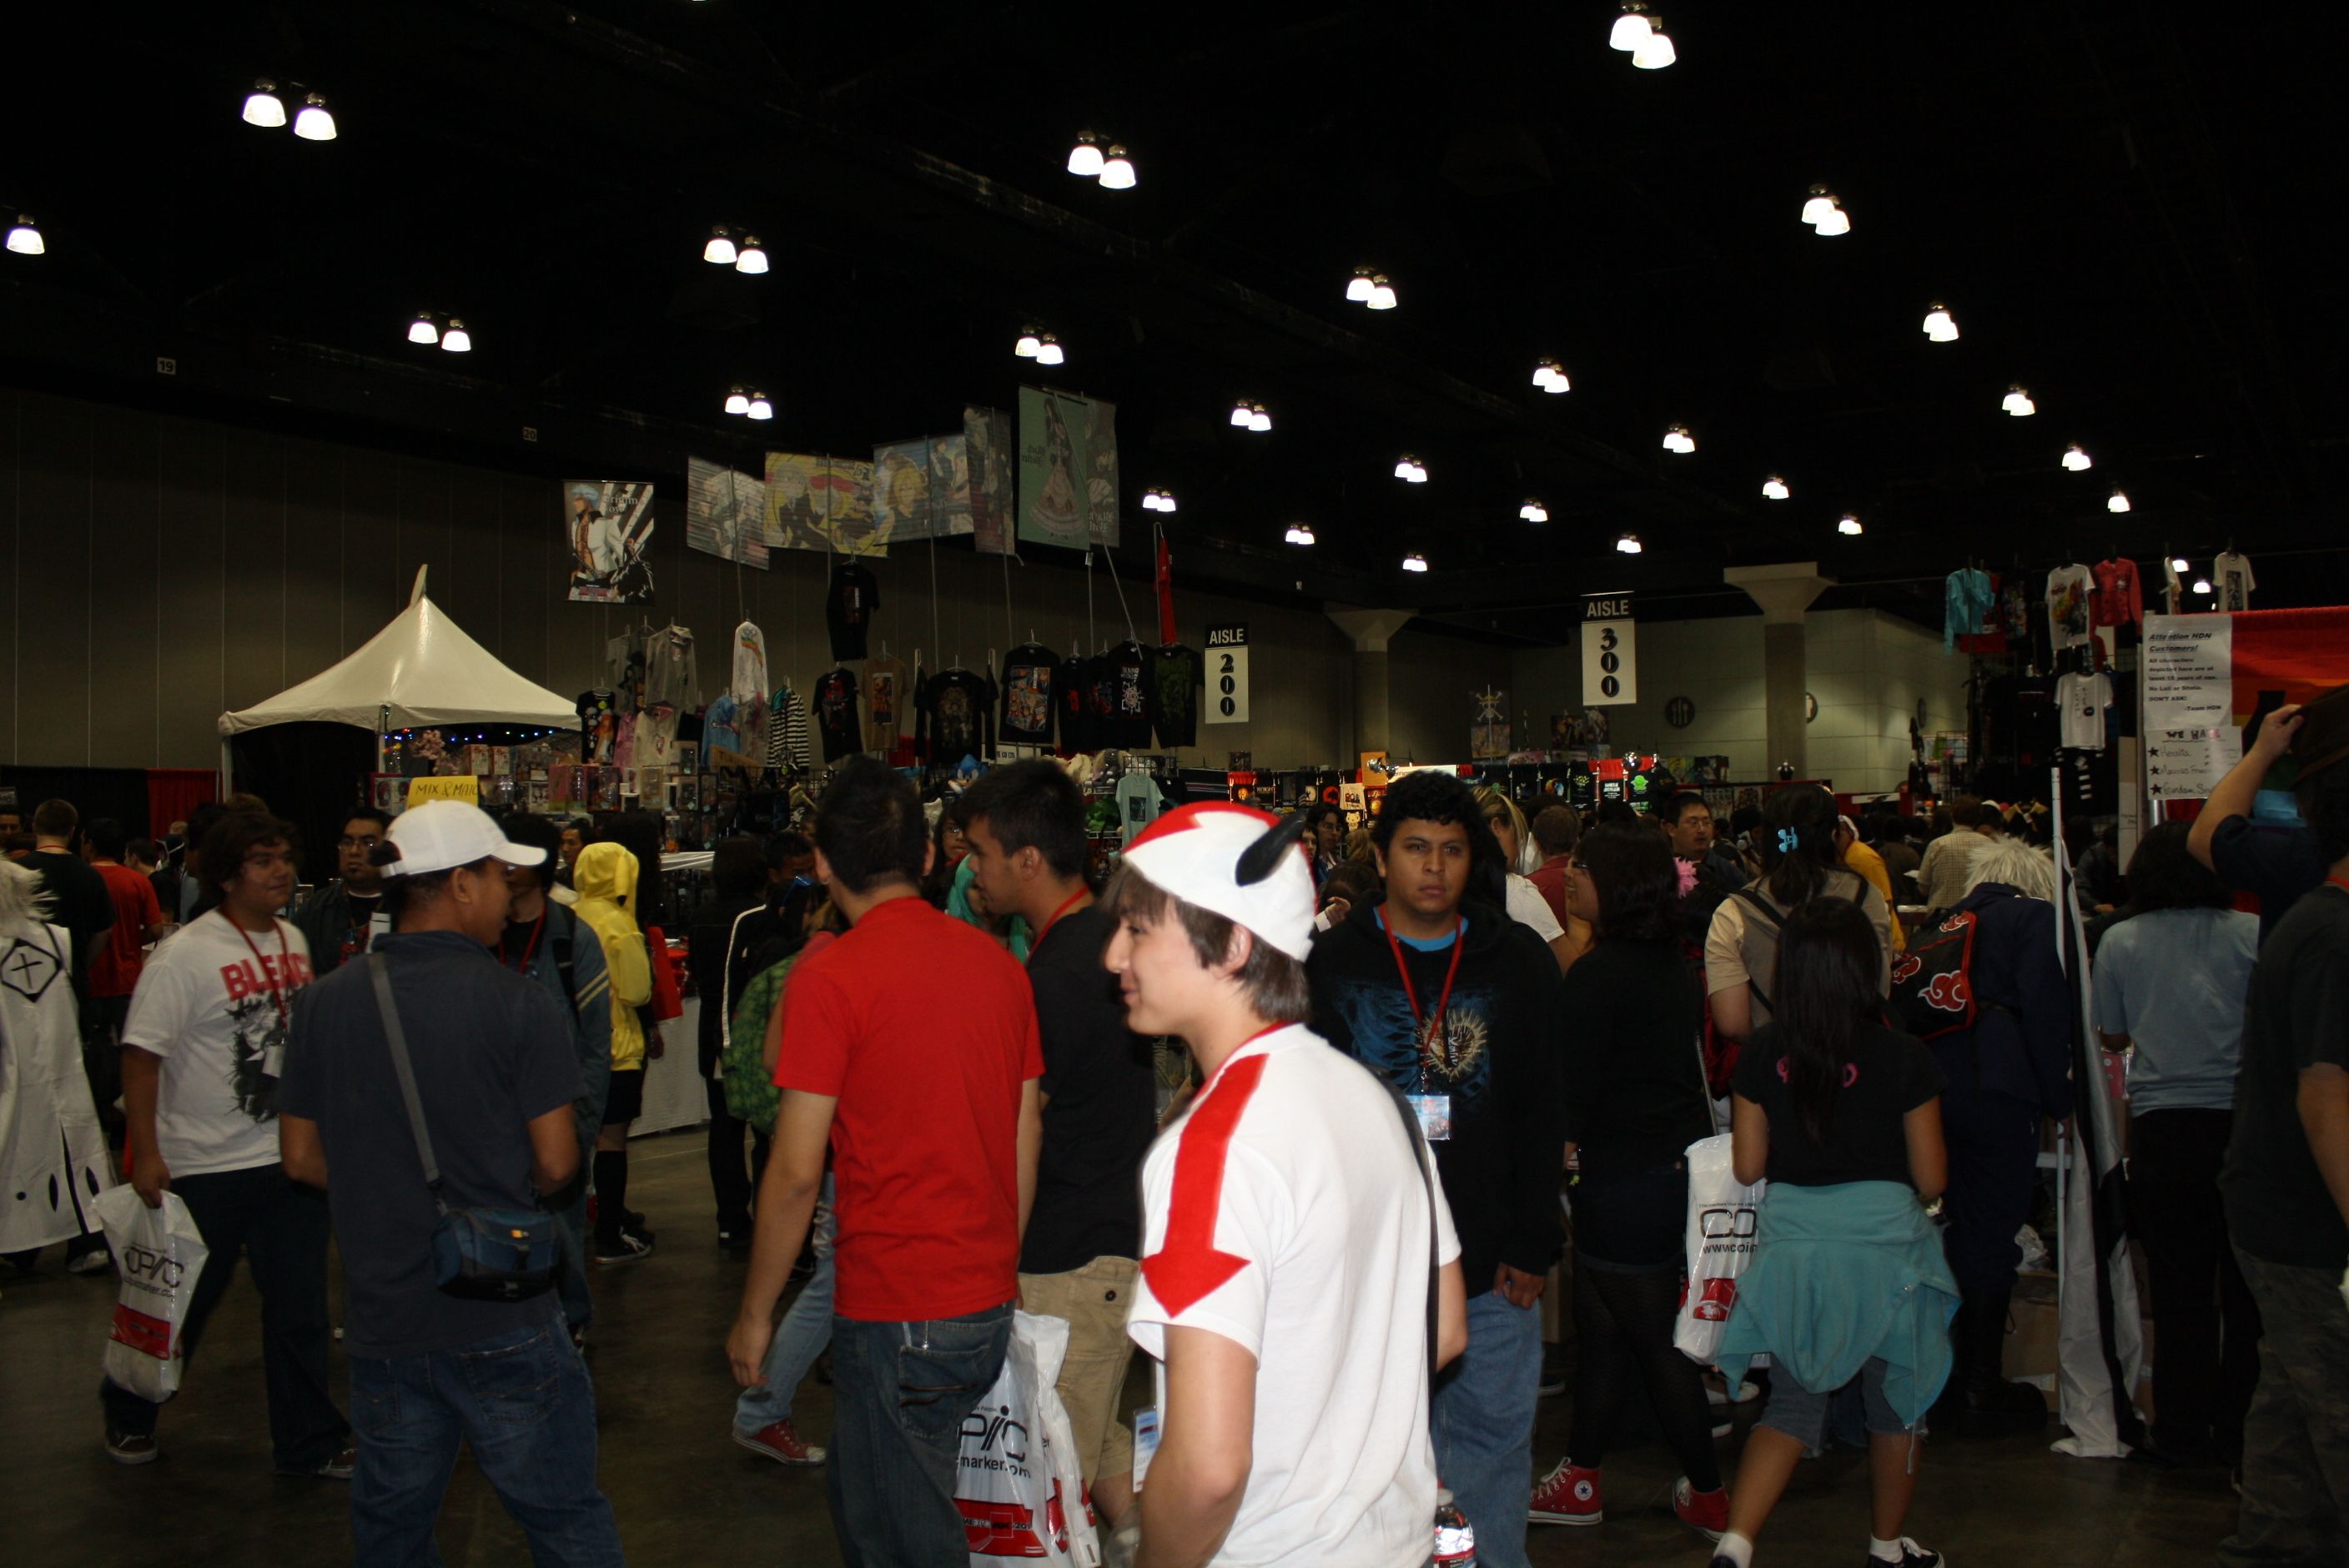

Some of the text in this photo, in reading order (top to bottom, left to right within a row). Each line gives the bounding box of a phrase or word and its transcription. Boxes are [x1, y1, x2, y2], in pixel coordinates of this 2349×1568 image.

[159, 360, 174, 373] 19
[524, 429, 536, 440] 20
[1586, 600, 1630, 618] AISLE
[1209, 628, 1245, 645] AISLE
[1600, 627, 1620, 697] 300
[1220, 653, 1235, 716] 200
[415, 784, 439, 795] MIX
